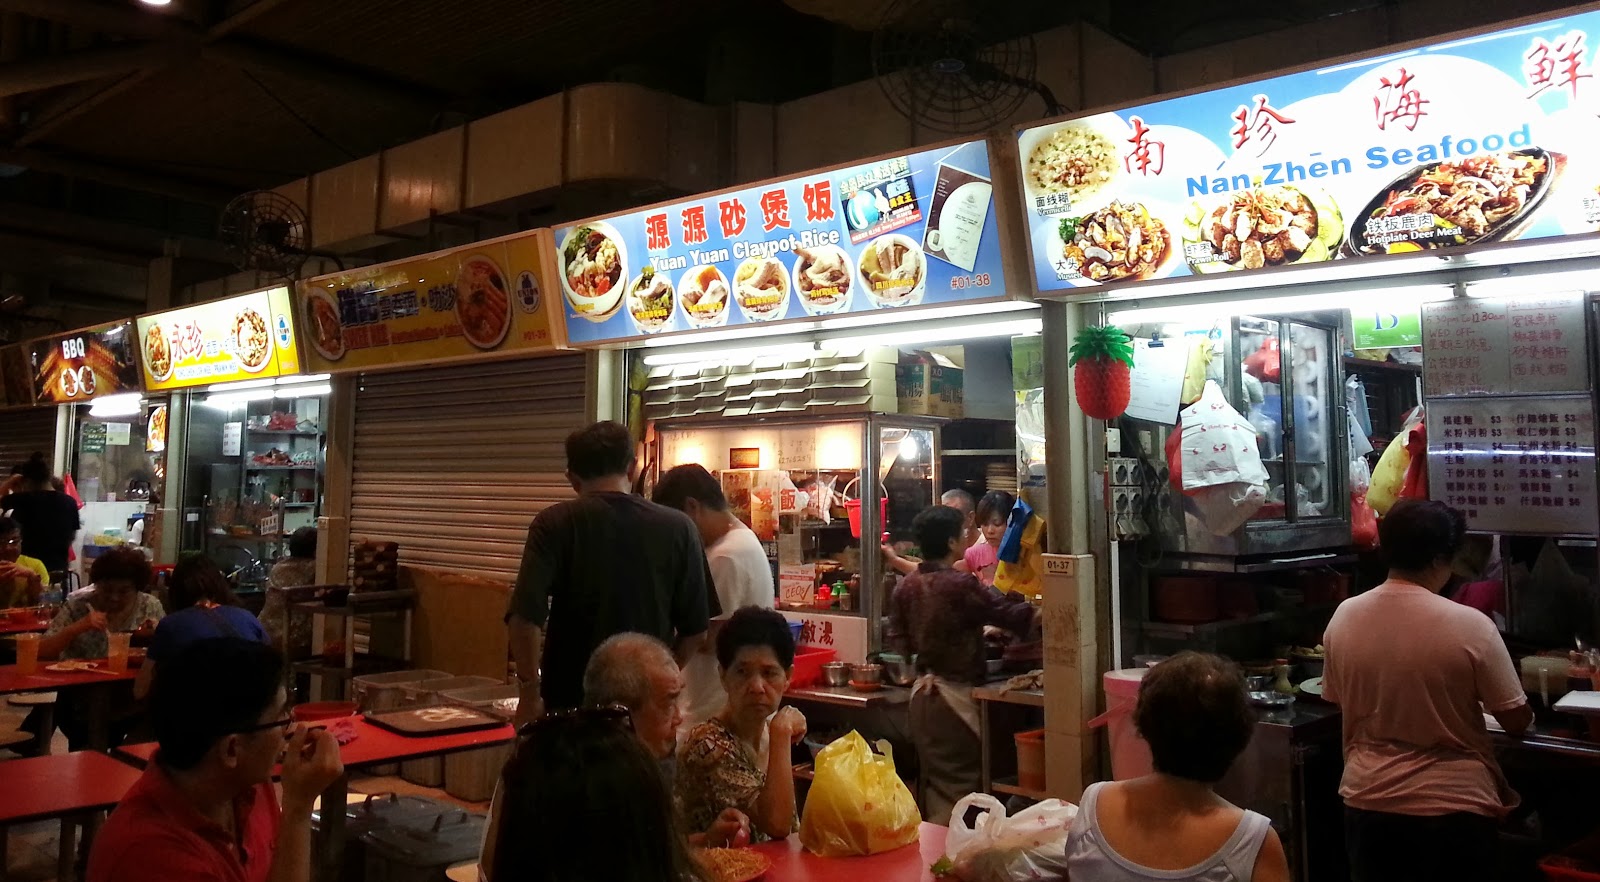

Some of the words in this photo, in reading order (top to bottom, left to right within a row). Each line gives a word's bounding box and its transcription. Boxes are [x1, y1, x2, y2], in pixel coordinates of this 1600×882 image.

[1366, 123, 1533, 170] Seafood
[645, 178, 836, 251] 源源砂煲饭
[1366, 213, 1435, 235] 铁板鹿肉
[1367, 233, 1410, 245] Hotplate
[1411, 230, 1435, 241] Deer
[1436, 227, 1462, 238] Meat
[649, 252, 688, 273] Yuan
[690, 246, 730, 268] Yuan
[733, 236, 799, 263] Claypot
[802, 228, 841, 252] Rice
[1187, 255, 1212, 265] Prawn
[1213, 252, 1231, 262] Roll
[951, 272, 991, 290] #01-38
[172, 320, 204, 361] 永珍
[62, 337, 86, 360] BBQ
[1491, 415, 1502, 424] $3
[1565, 413, 1576, 423] $3
[1491, 428, 1503, 437] $3
[1565, 427, 1577, 436] $3
[1492, 442, 1503, 450] $4
[1566, 441, 1577, 450] $4
[1567, 469, 1579, 478] $4
[780, 488, 796, 511] 飯
[1047, 560, 1070, 571] 01-37
